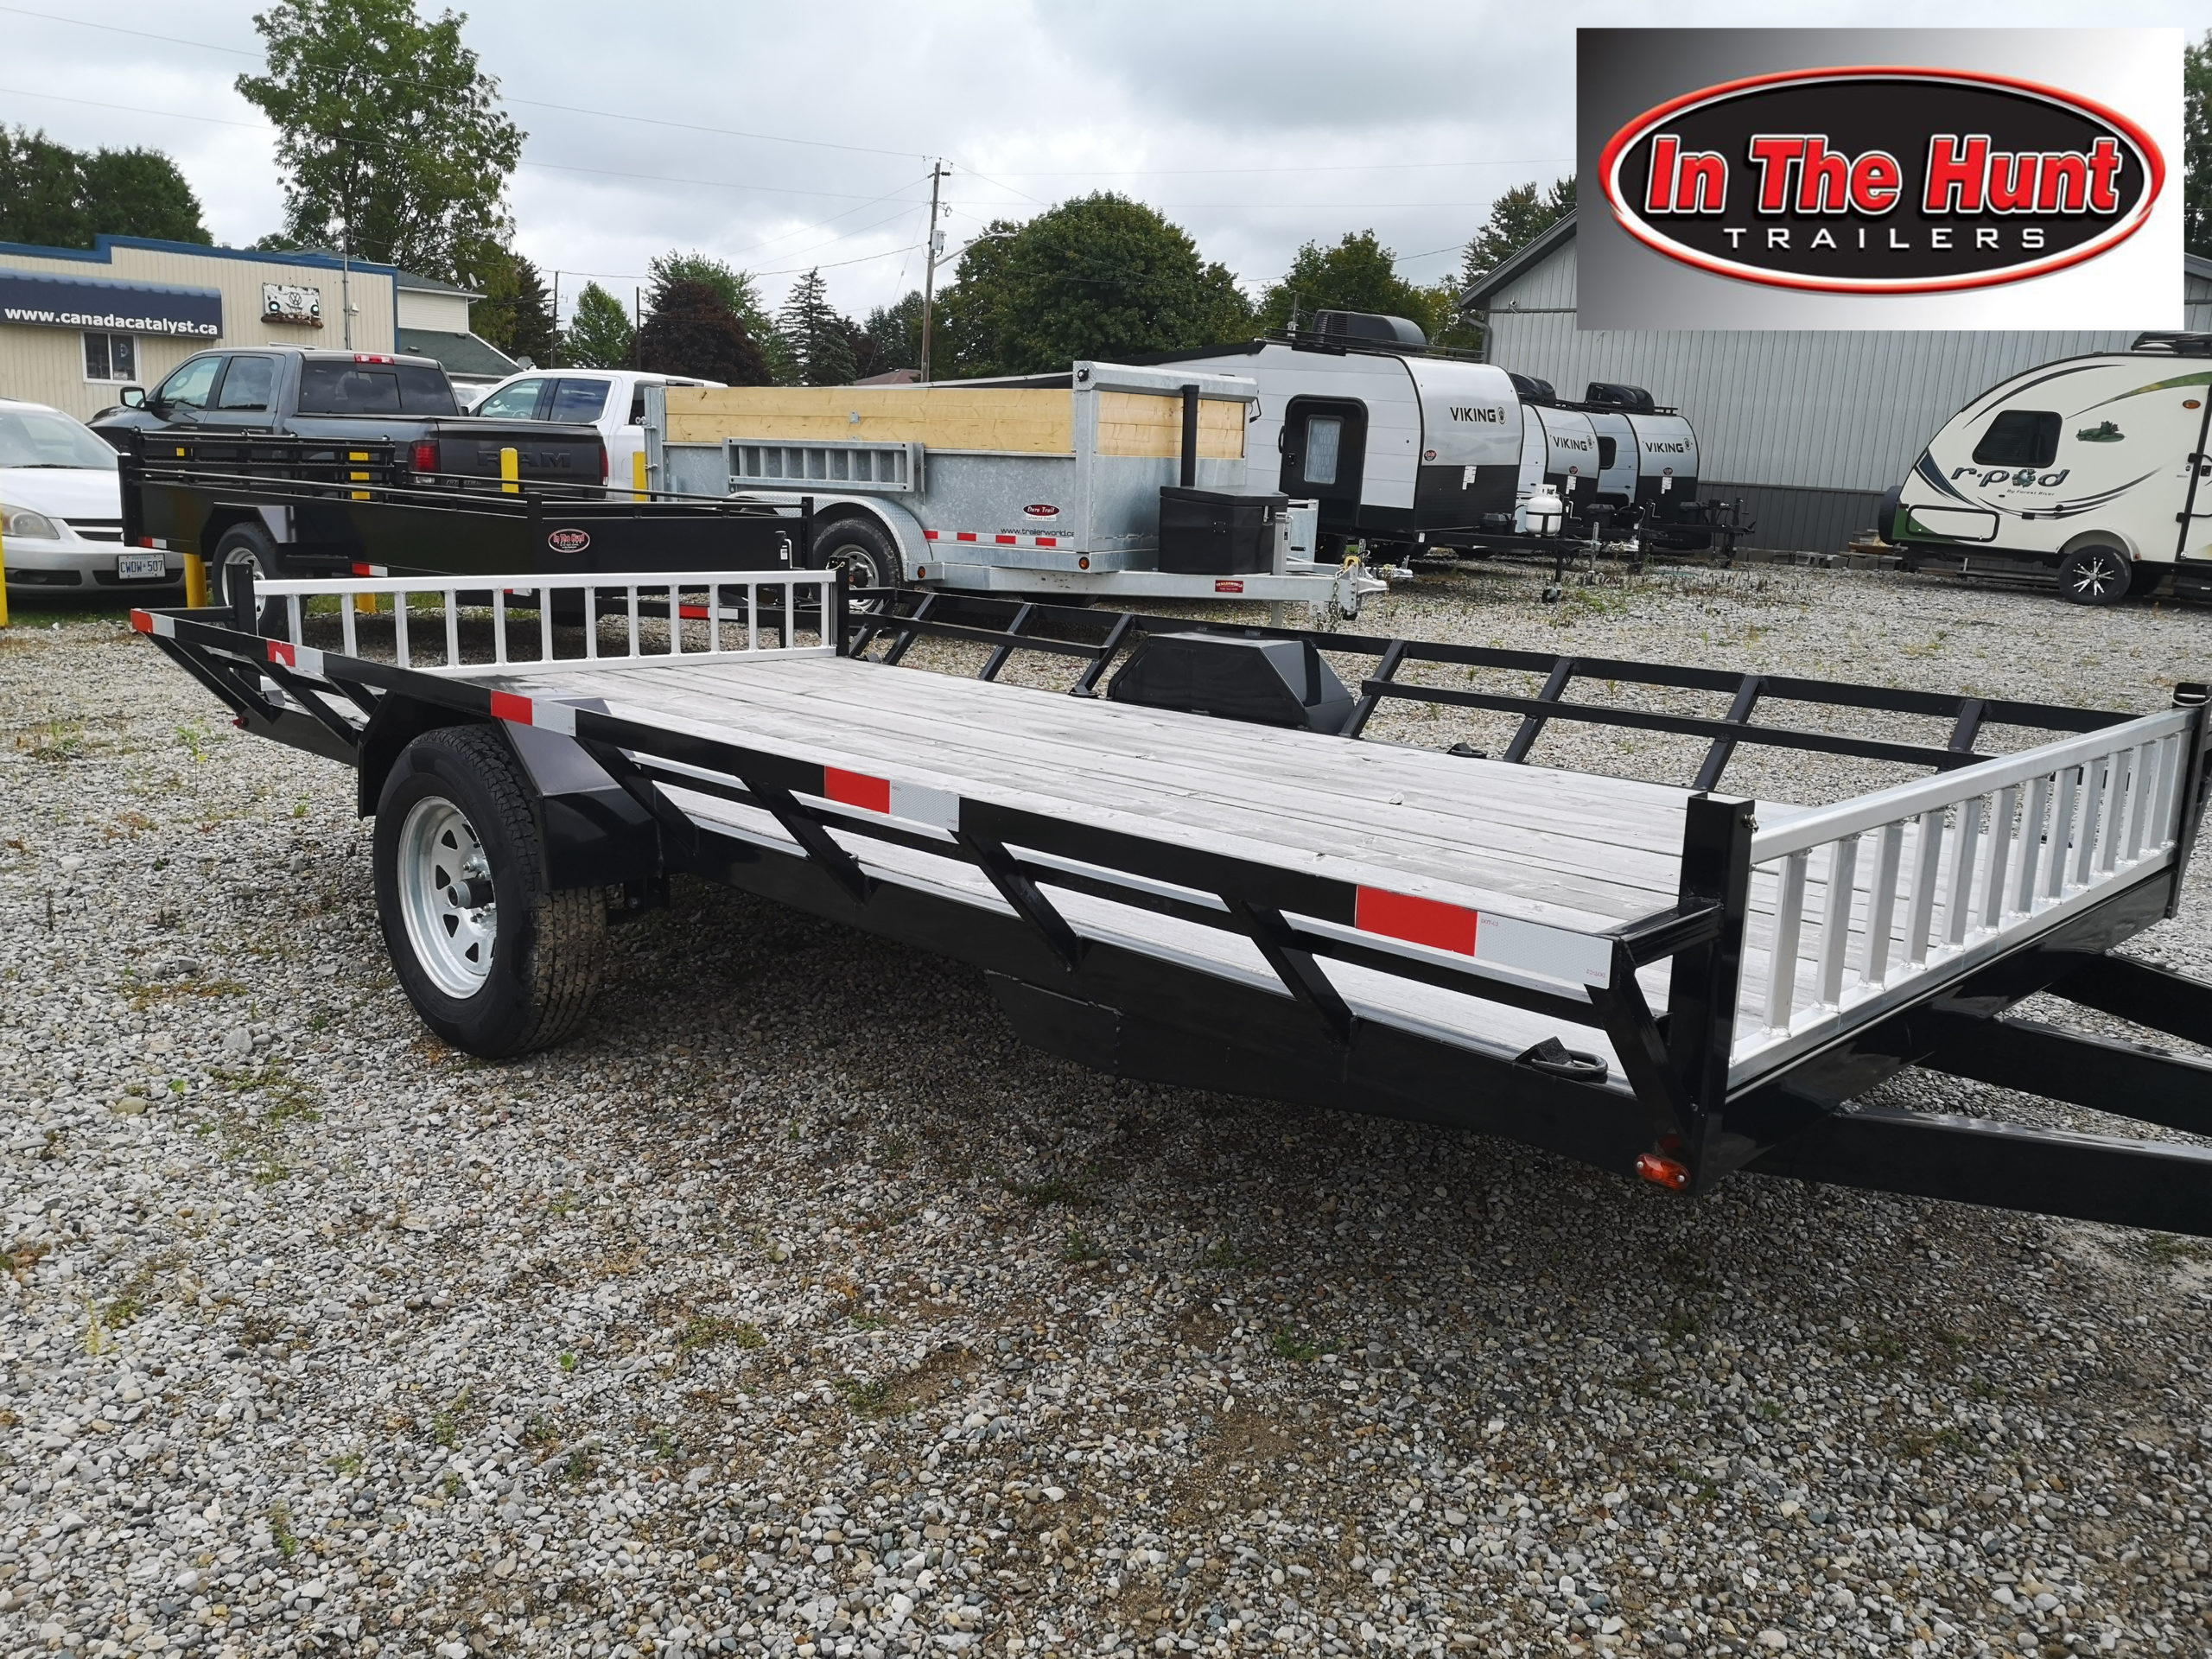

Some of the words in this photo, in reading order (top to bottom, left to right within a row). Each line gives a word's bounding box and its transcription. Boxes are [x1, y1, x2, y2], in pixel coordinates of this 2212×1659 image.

[4, 308, 218, 335] www.canadacatalyst.ca
[1450, 407, 1497, 423] VIKING
[1552, 435, 1588, 452] VIKING
[1644, 442, 1684, 454] VIKING
[147, 560, 163, 572] 507
